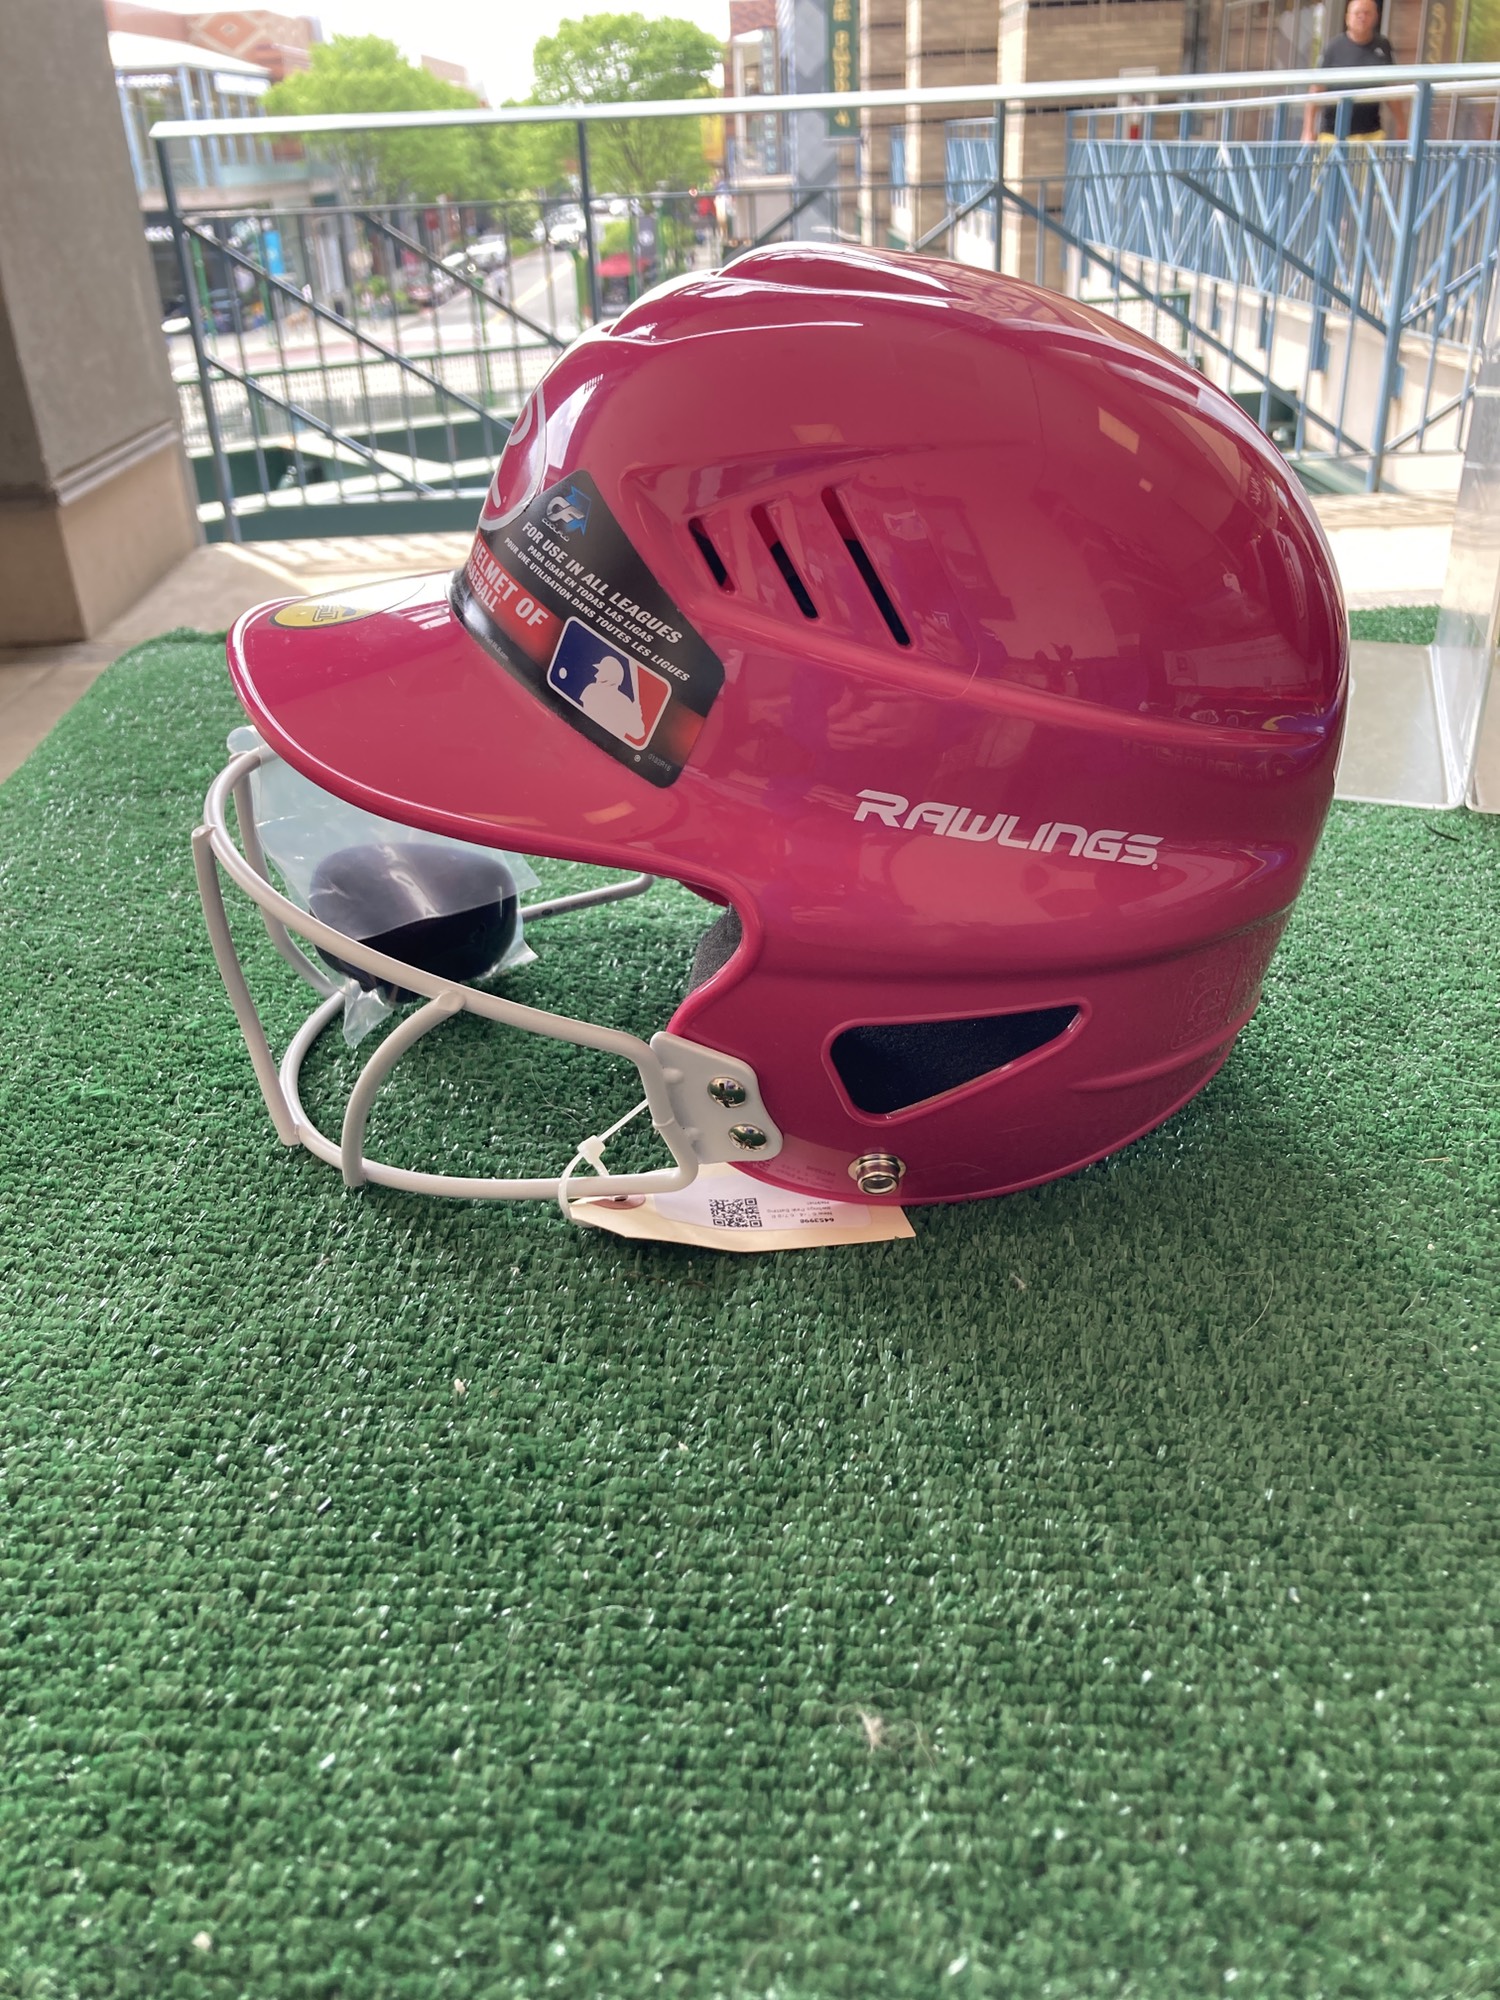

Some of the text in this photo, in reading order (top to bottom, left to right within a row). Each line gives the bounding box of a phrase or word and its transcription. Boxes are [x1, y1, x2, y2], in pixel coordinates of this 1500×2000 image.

[467, 559, 495, 613] ASEBALL
[472, 538, 519, 601] HELMET
[515, 597, 549, 627] OF
[504, 537, 690, 681] POUR UNE UTILISATION DANS TOUTES LES LIGUES
[522, 521, 683, 643] FOR USE IN ALL LEAGUES
[527, 545, 655, 643] PARA USAR EN TODAS LAS LIGAS
[853, 789, 1164, 867] RAWLINGS
